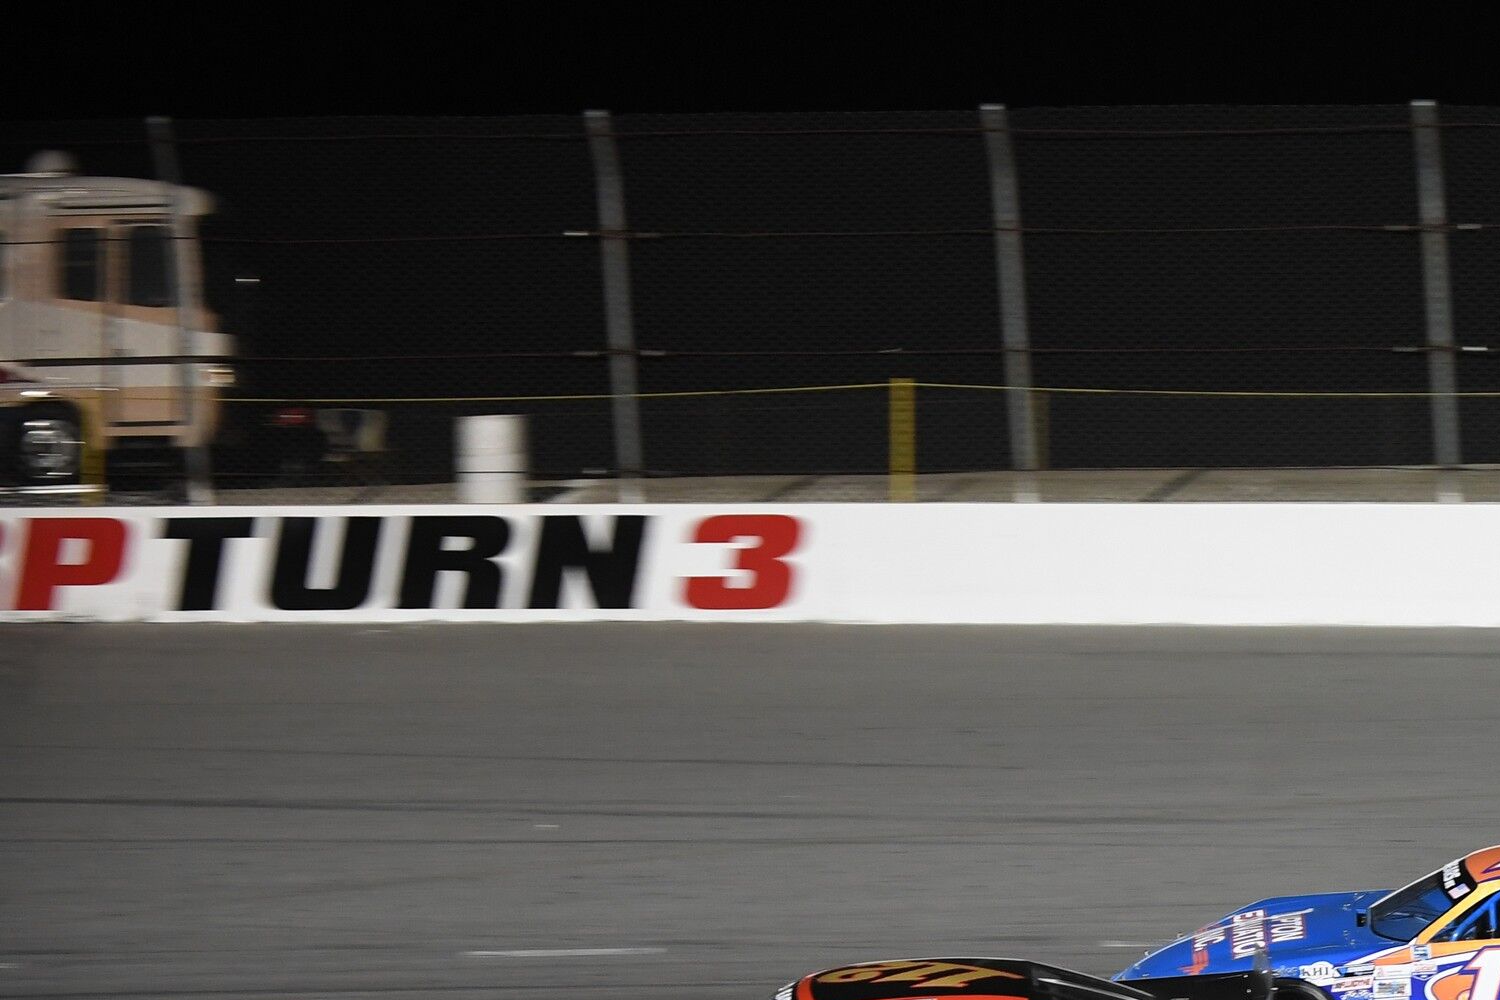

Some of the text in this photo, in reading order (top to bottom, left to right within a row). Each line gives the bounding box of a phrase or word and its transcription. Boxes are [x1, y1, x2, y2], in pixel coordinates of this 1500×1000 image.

[0, 514, 806, 612] P TURN 3
